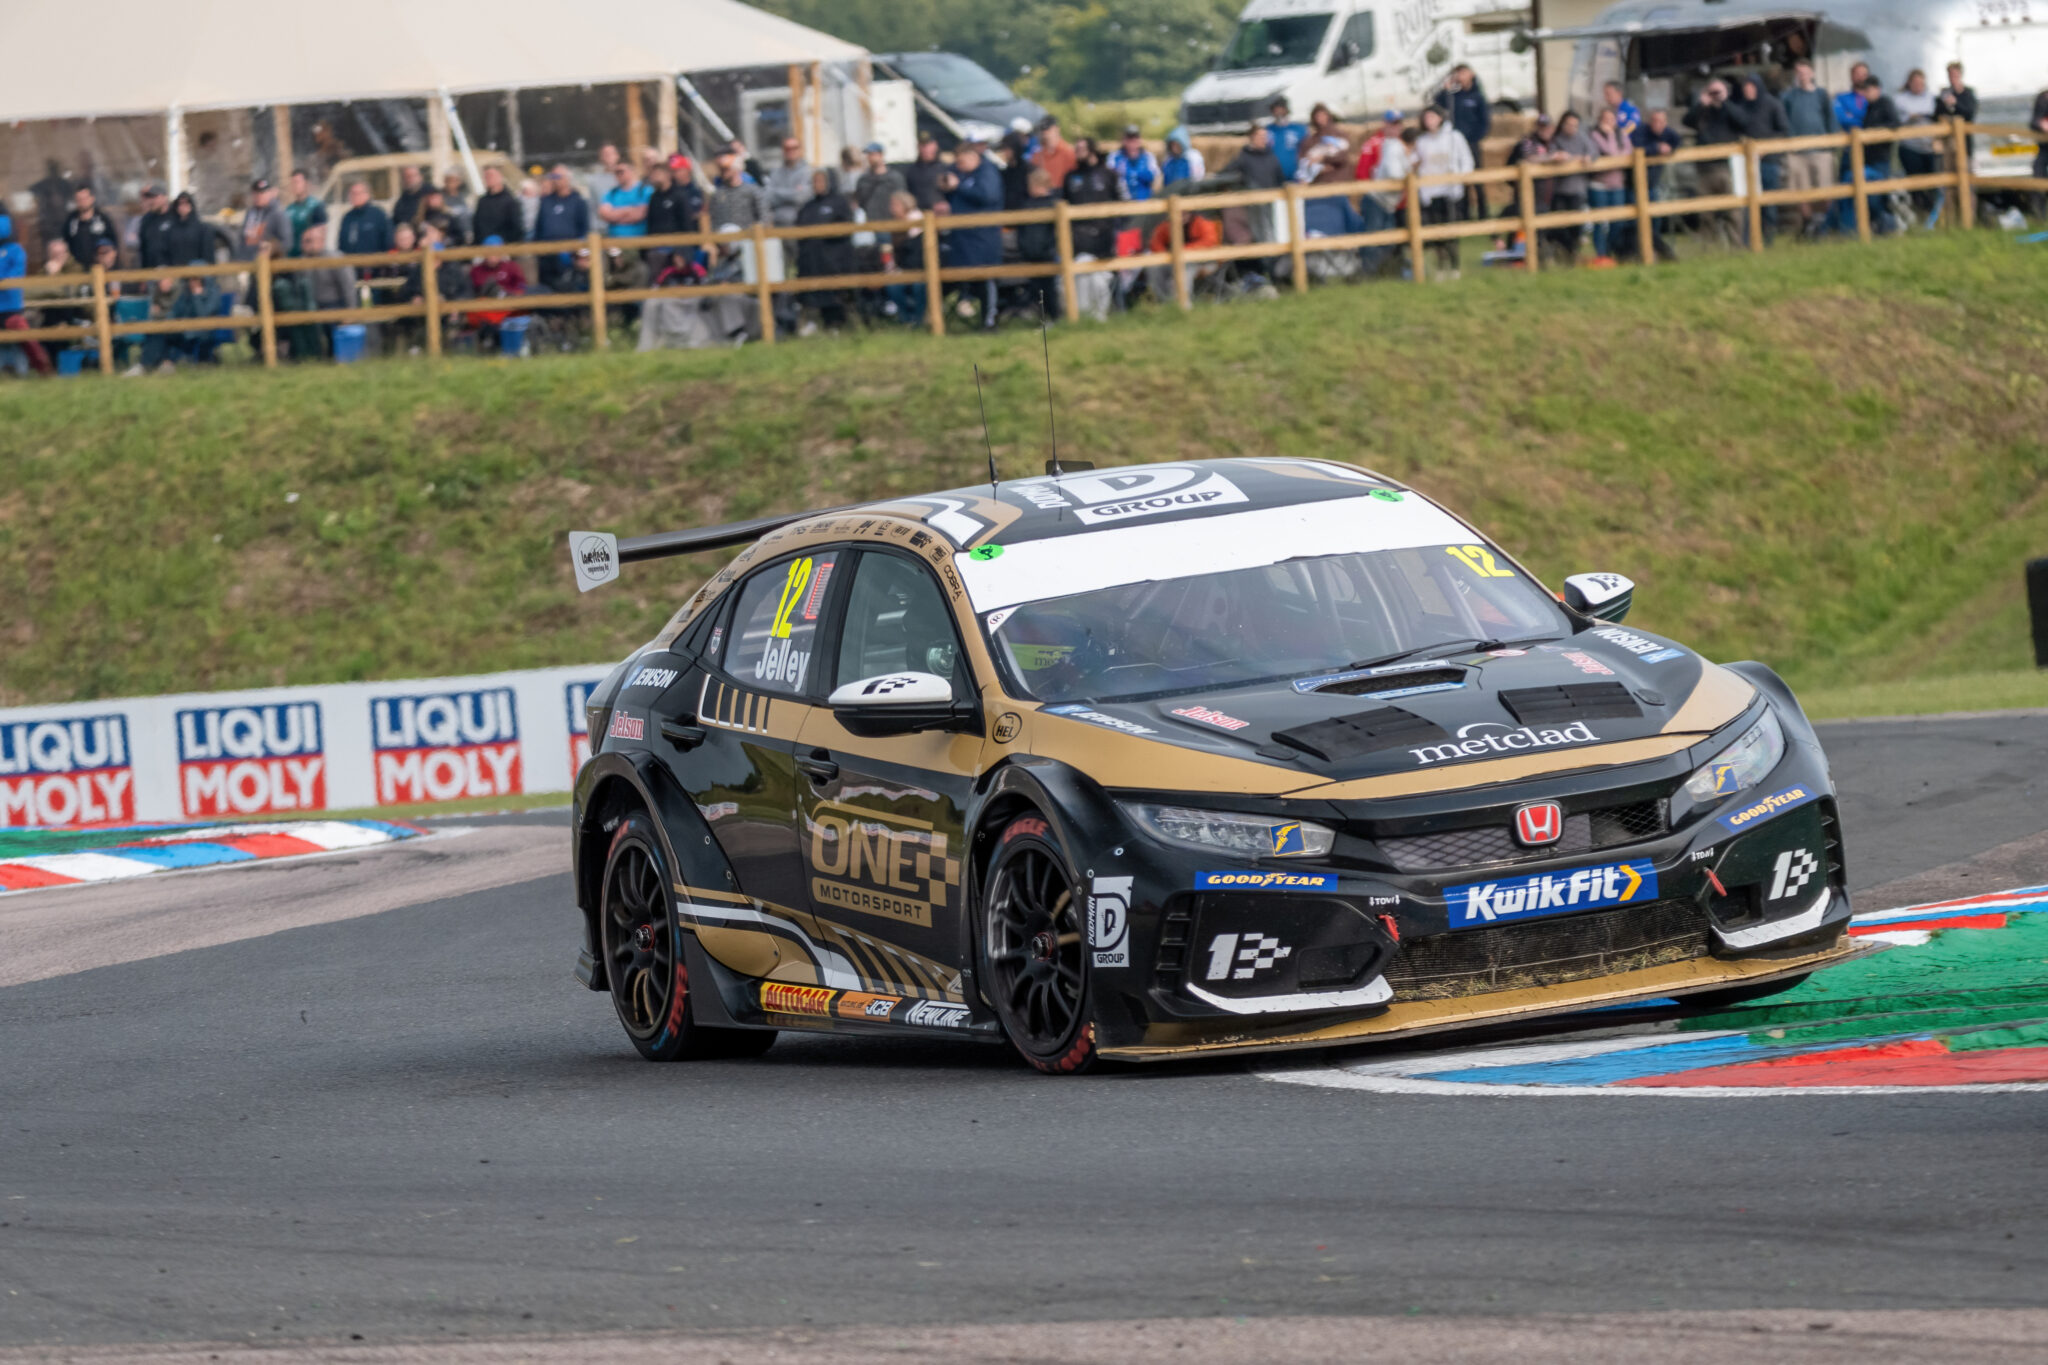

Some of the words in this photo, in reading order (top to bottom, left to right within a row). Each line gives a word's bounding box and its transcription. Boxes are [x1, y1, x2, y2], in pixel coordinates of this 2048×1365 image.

[1092, 491, 1223, 516] GROUP
[1445, 545, 1515, 577] 12
[771, 557, 812, 638] 12
[943, 564, 963, 598] COBRA
[1592, 628, 1664, 655] JEWSON
[632, 668, 678, 689] JEWSON
[755, 637, 810, 692] Jelley
[181, 704, 317, 760] LIQUI
[375, 690, 514, 747] LIQUI
[610, 711, 644, 740] Jelson
[996, 723, 1014, 738] HEL
[1172, 706, 1250, 731] Jelson
[1409, 721, 1600, 764] metclad
[185, 756, 323, 814] MOLY
[379, 743, 518, 801] MOLY
[0, 770, 131, 828] MOLY
[1730, 788, 1806, 826] GOODYEAR
[811, 815, 919, 893] ONE
[1207, 873, 1325, 887] GOODYEAR
[820, 884, 922, 919] MOTORSPORT
[1374, 896, 1395, 905] TOW
[1097, 953, 1124, 965] GROUP
[766, 984, 831, 1016] AUTOCAR
[865, 999, 894, 1016] JCB
